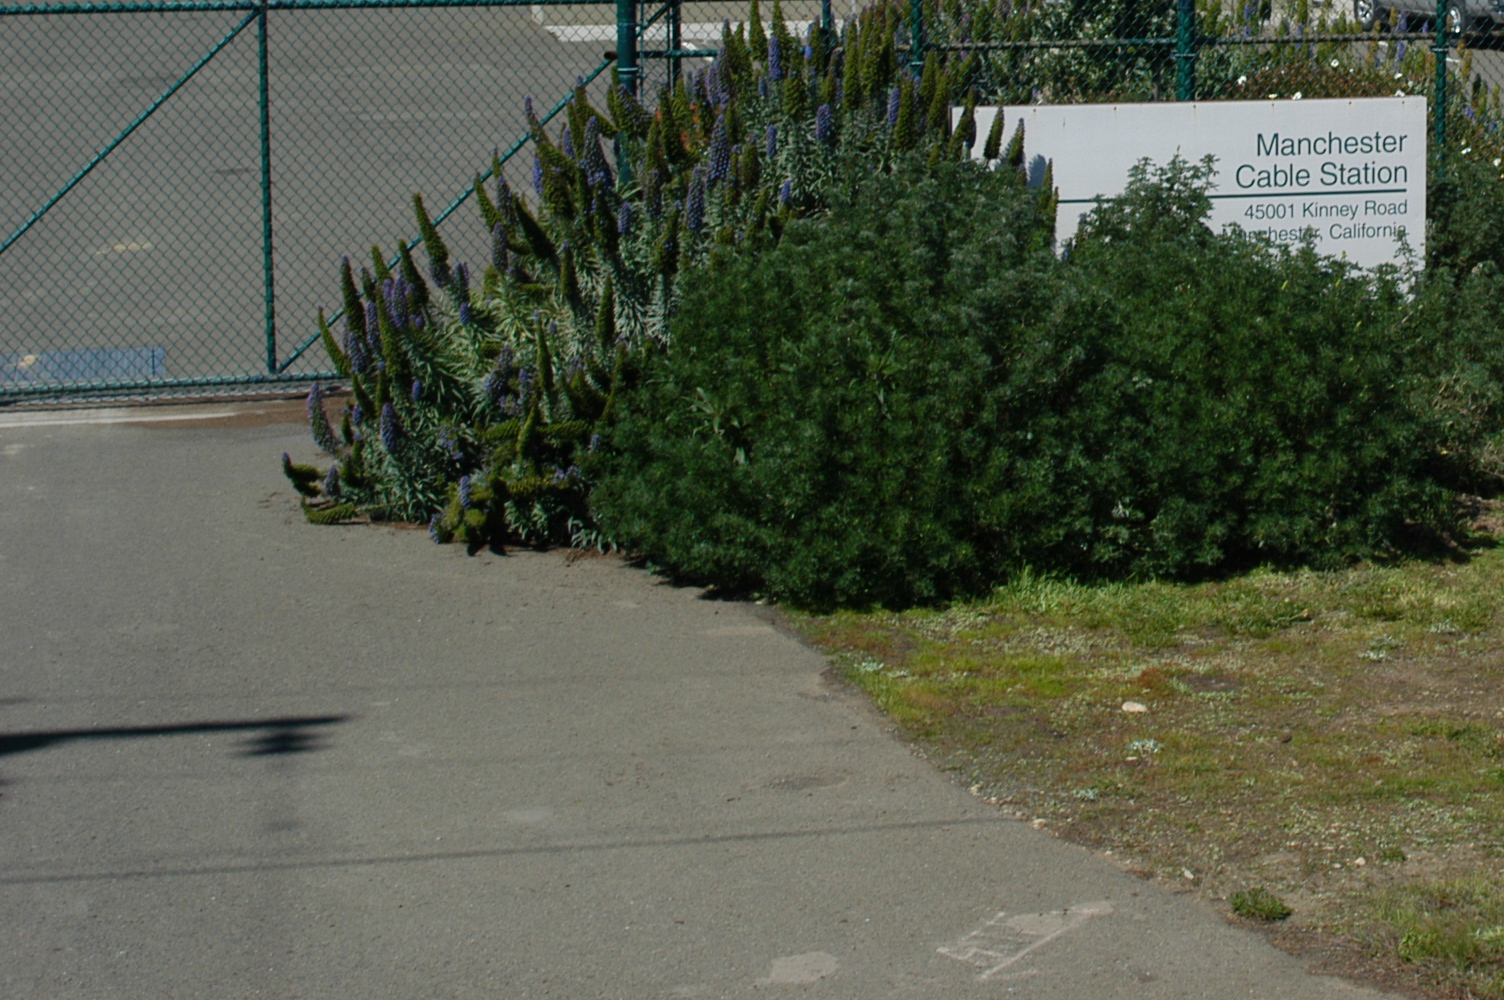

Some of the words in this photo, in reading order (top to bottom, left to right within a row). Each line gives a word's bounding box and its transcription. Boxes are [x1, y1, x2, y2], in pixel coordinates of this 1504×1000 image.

[1257, 131, 1408, 156] Manchester
[1235, 164, 1311, 189] Cable
[1320, 161, 1408, 186] Station
[1244, 204, 1295, 219] 45001
[1302, 202, 1359, 220] Kinney
[1364, 200, 1408, 215] Road
